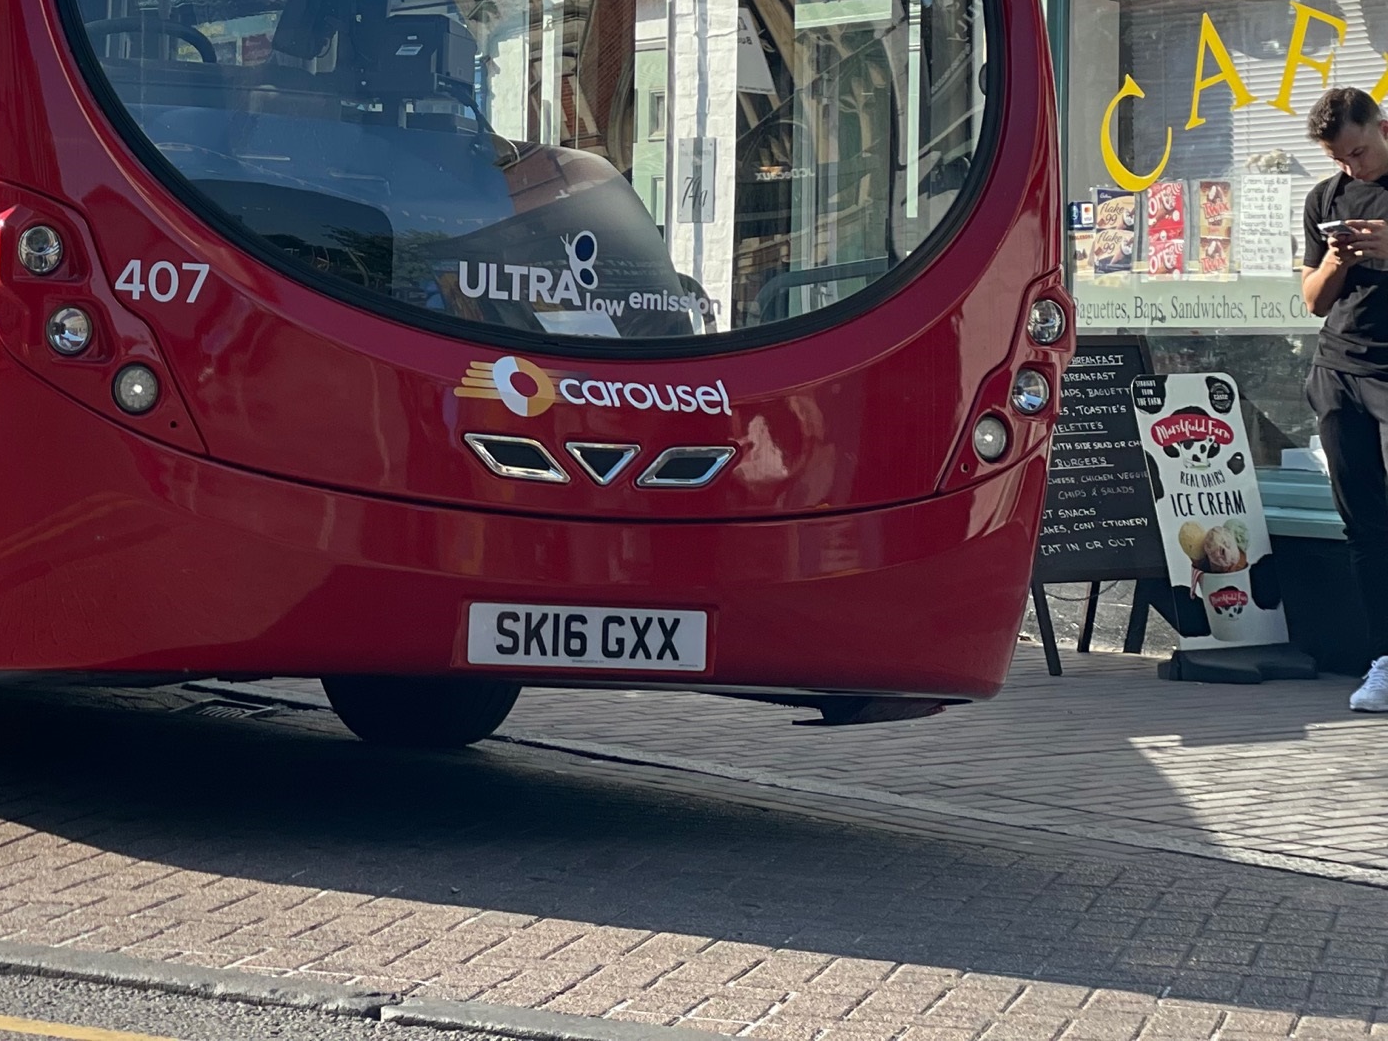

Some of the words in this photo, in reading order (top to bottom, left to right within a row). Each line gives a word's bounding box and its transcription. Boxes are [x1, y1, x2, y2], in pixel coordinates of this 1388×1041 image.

[1100, 202, 1124, 215] flake
[1105, 214, 1118, 226] 99
[1097, 231, 1123, 244] flake
[1103, 243, 1116, 254] 99
[114, 259, 210, 303] 407
[459, 261, 582, 306] ULTRA
[586, 292, 625, 317] low
[628, 290, 722, 315] emission
[1170, 295, 1247, 320] Sandwiches,
[1252, 295, 1285, 322] Teas,
[1290, 294, 1313, 319] Co
[559, 377, 733, 416] carousel
[1180, 470, 1200, 488] REAL
[1202, 469, 1225, 488] DAIRY
[1170, 492, 1195, 517] ICE
[1197, 490, 1246, 515] CREAM
[1066, 542, 1080, 551] IN
[1085, 540, 1103, 549] OR
[1108, 537, 1135, 546] OUT
[495, 611, 588, 657] SK16
[601, 615, 680, 661] GXX
